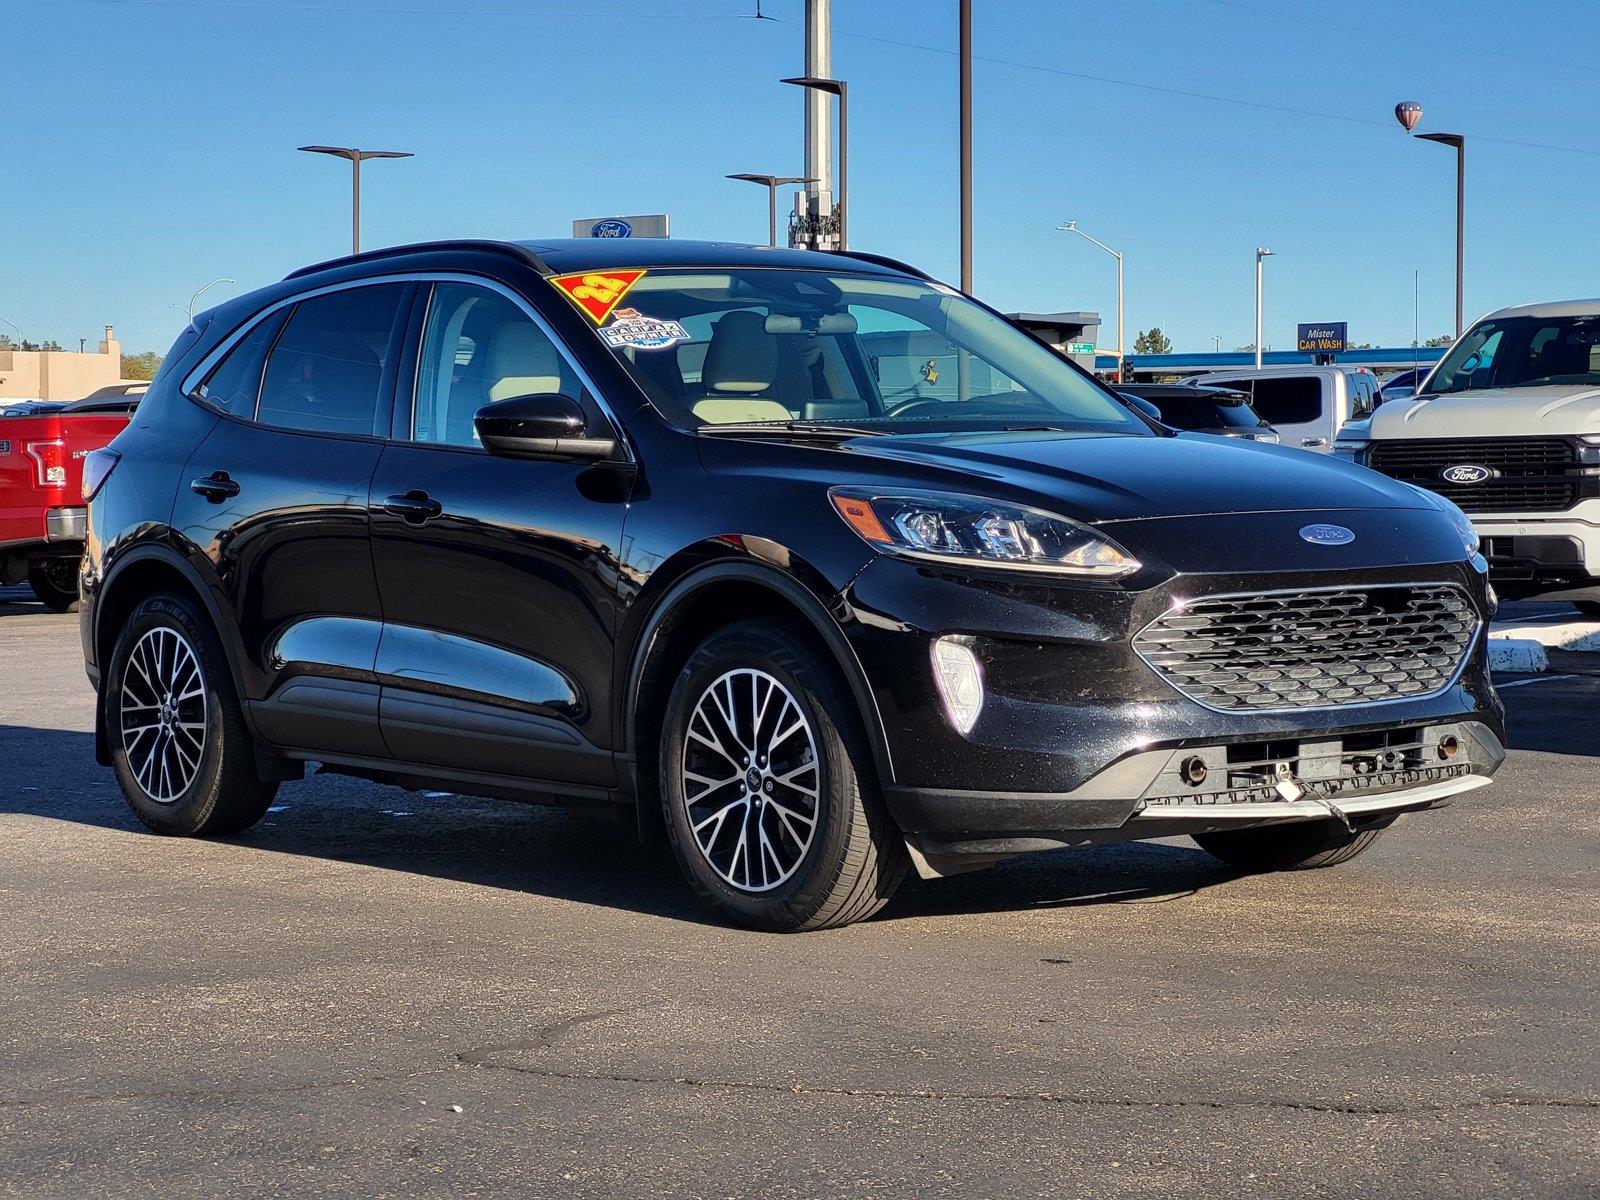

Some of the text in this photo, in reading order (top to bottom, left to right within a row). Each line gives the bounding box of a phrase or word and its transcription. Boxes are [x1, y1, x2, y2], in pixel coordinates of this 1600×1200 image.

[598, 223, 621, 238] Ford
[572, 275, 628, 303] 22
[606, 323, 675, 337] CARFAX
[623, 330, 682, 342] OWNER
[1308, 328, 1335, 338] Mister
[1300, 340, 1342, 350] CAR WASH
[1452, 467, 1479, 480] Ford
